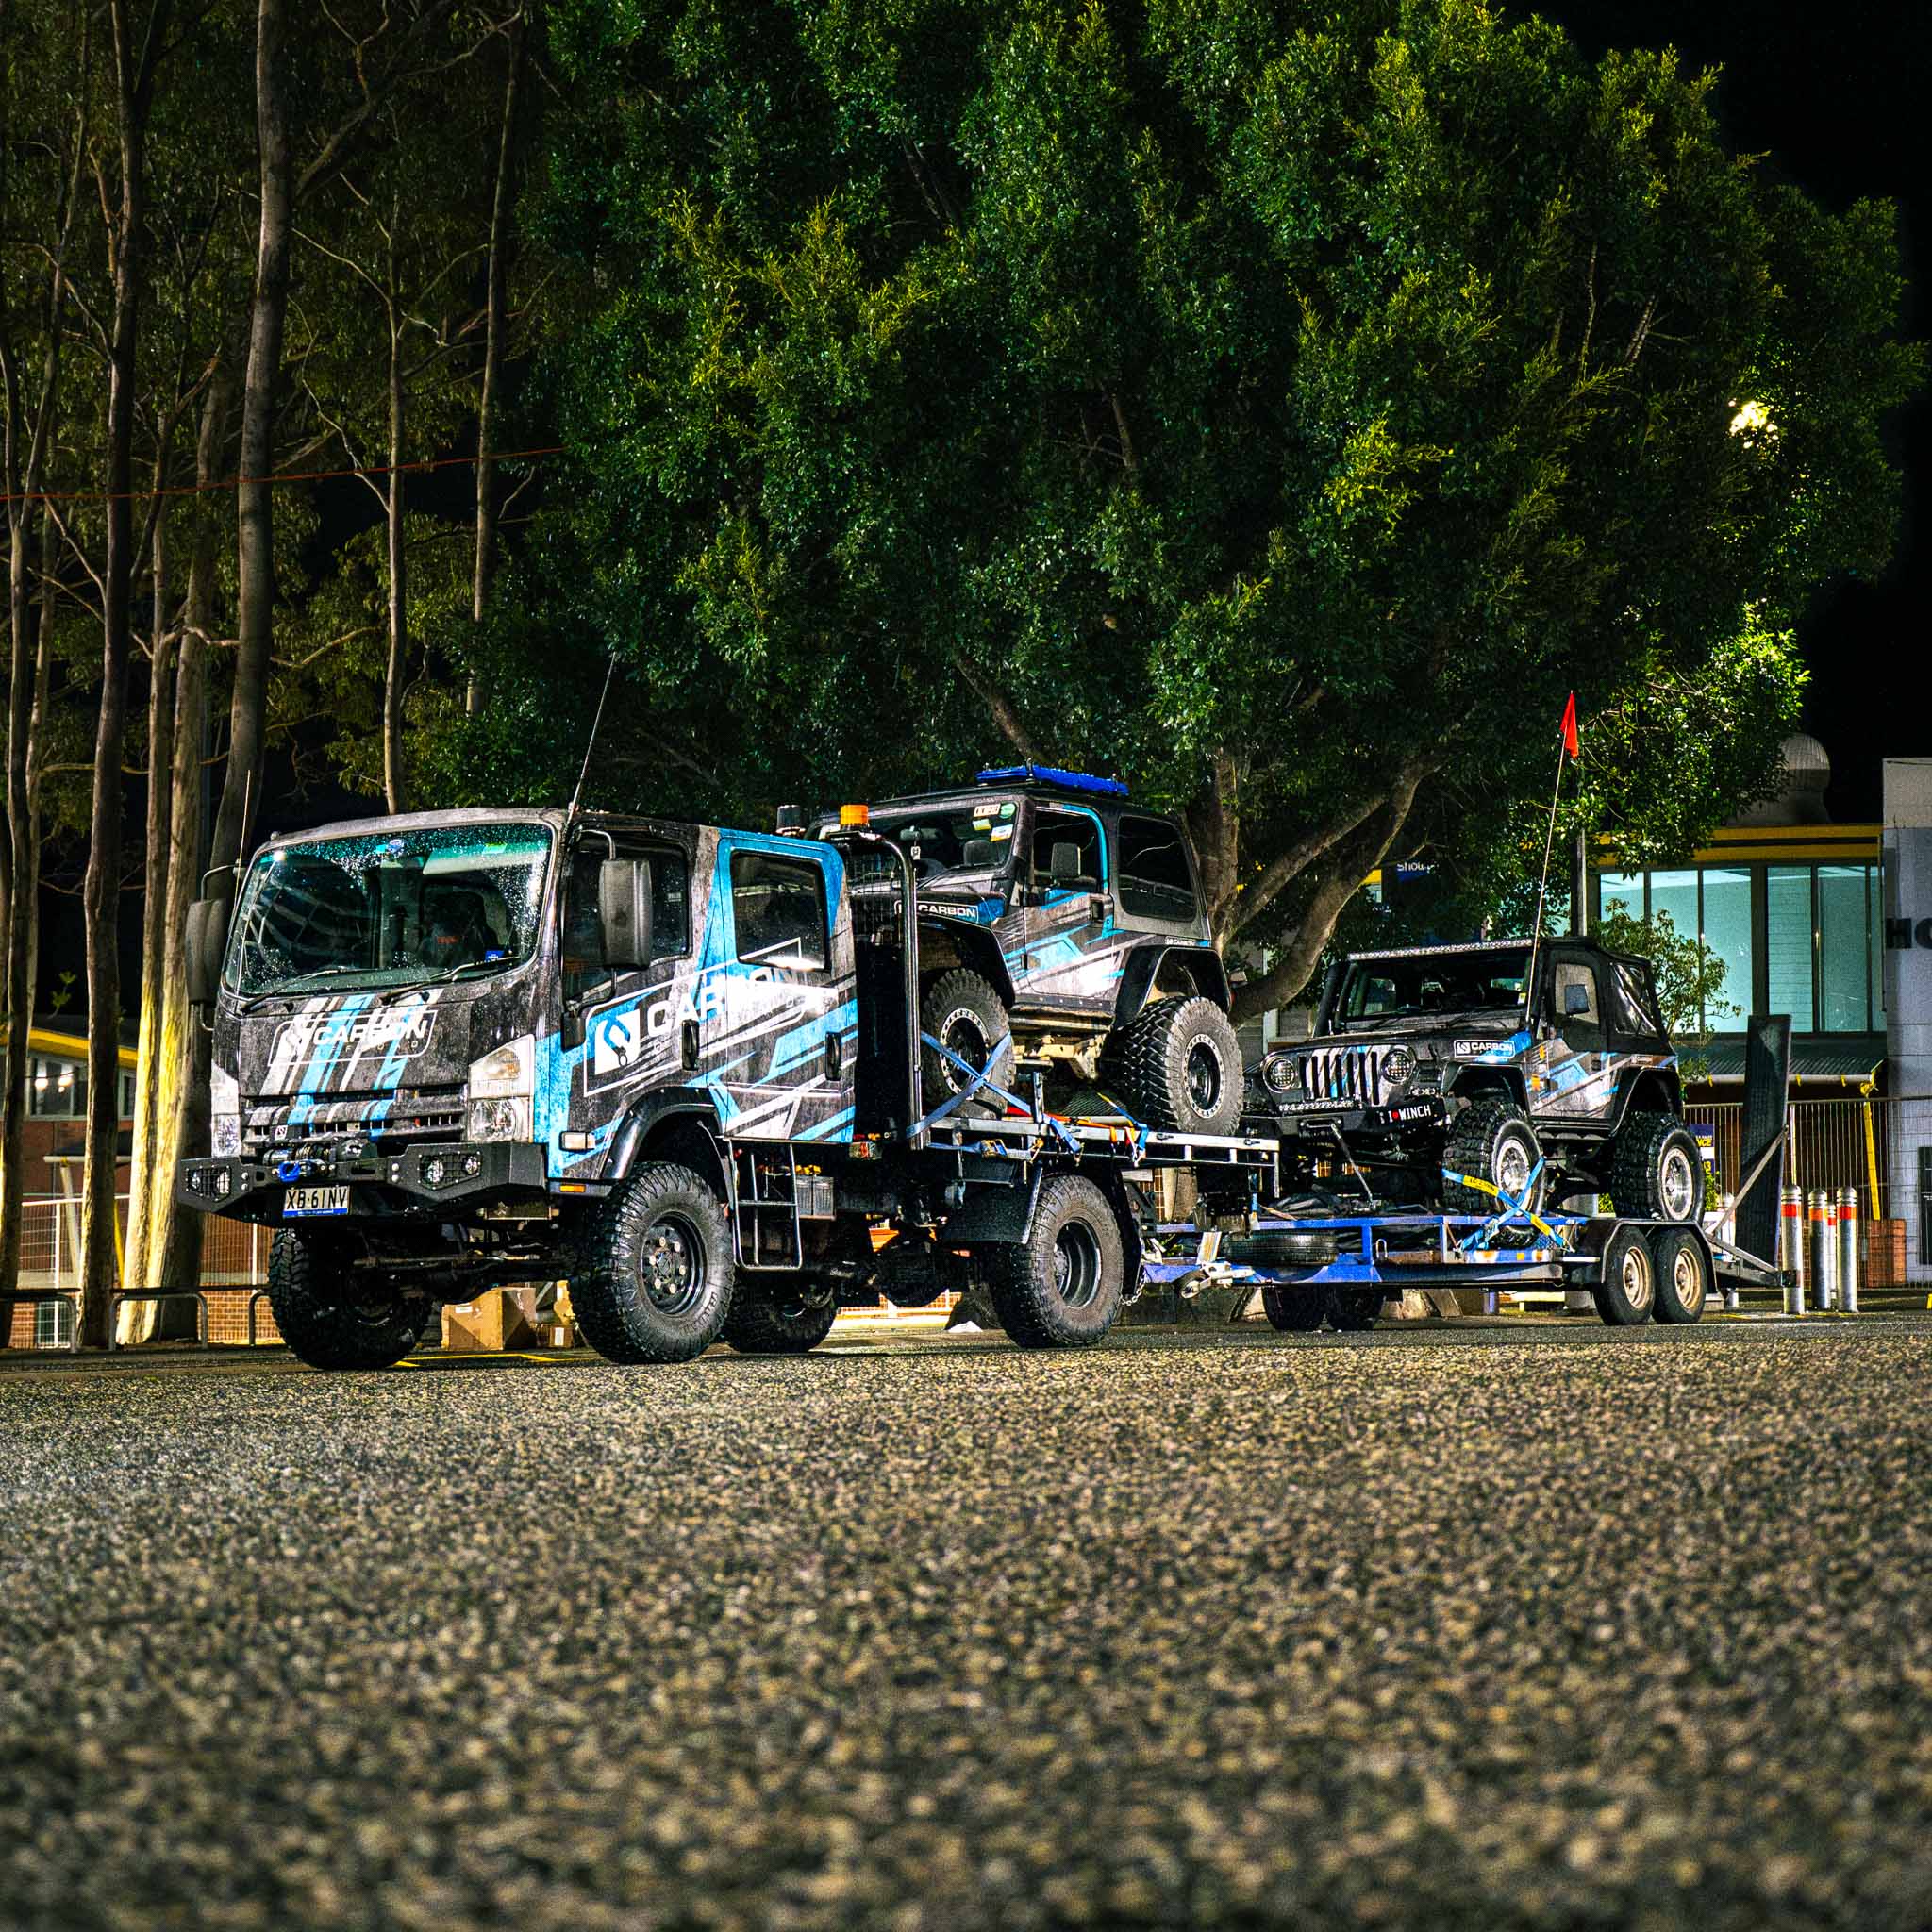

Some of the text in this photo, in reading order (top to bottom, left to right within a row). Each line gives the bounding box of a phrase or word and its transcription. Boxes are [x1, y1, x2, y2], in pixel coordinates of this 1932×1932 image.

[918, 904, 975, 918] CARBON
[1472, 1042, 1512, 1051] CARBON
[1398, 1104, 1431, 1121] WINCH
